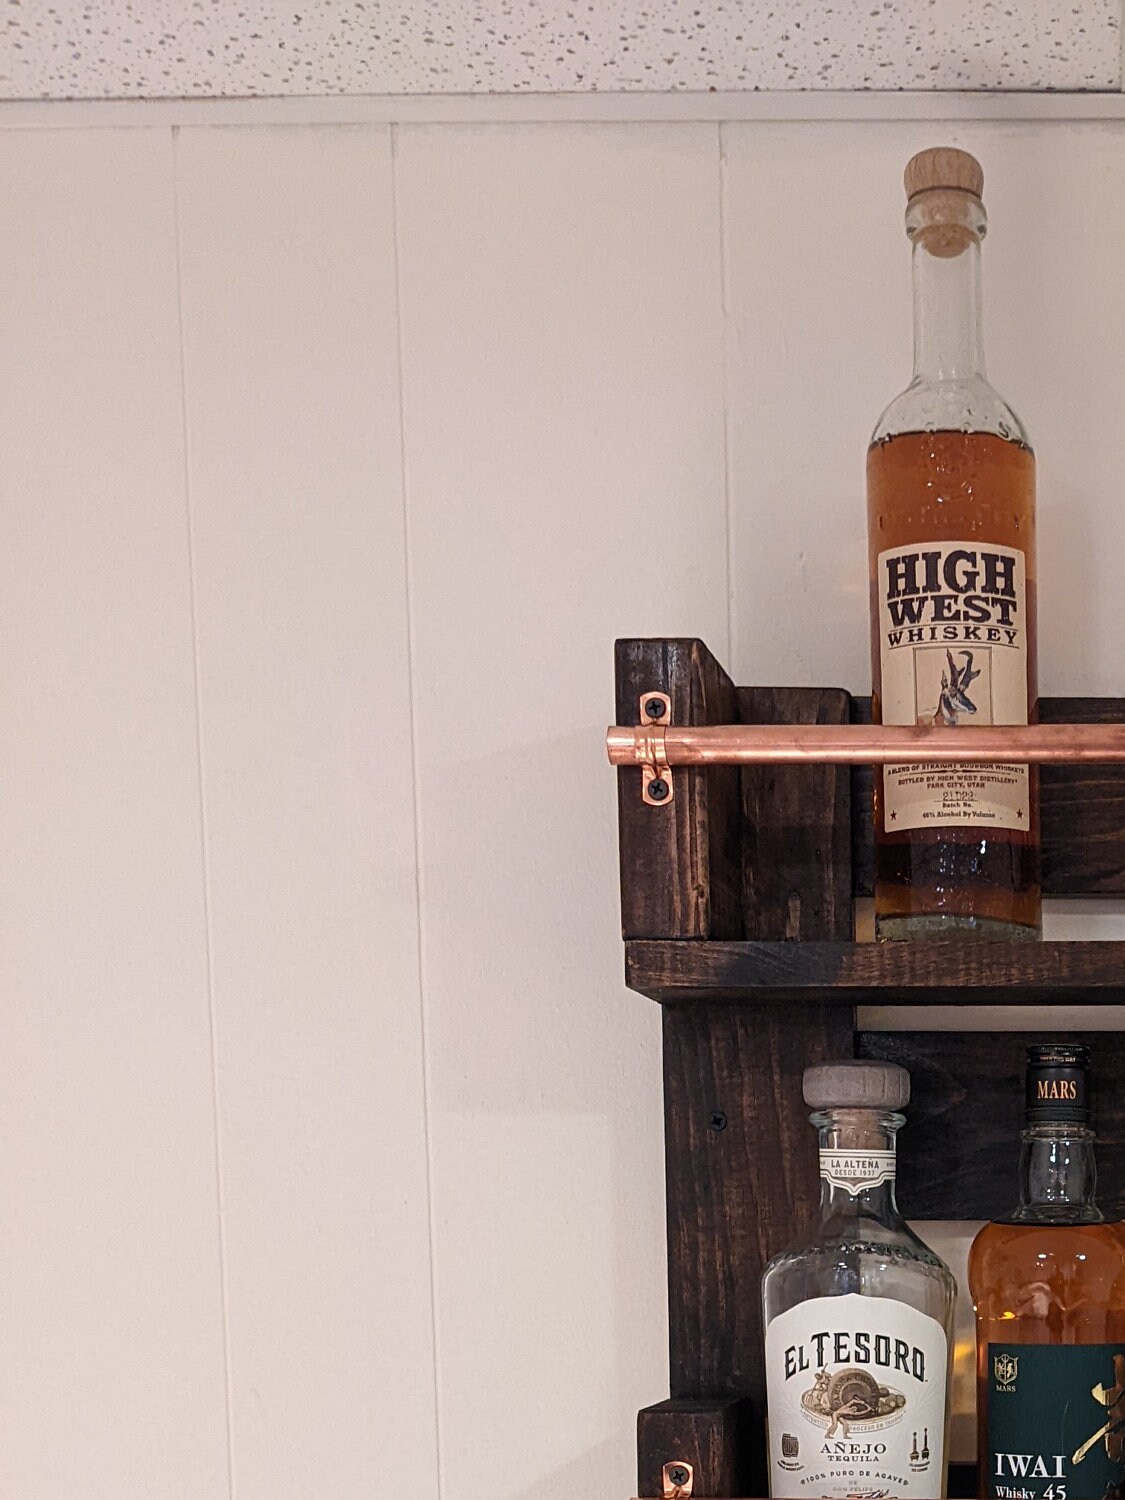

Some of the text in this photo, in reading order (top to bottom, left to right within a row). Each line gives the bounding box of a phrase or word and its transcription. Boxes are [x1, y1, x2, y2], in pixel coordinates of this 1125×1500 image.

[886, 550, 1016, 599] HIGH
[888, 595, 1017, 628] WEST
[888, 626, 1017, 646] WHISKEY
[898, 777, 924, 786] BOTTLED
[962, 811, 971, 819] By
[1037, 1080, 1077, 1100] MARS
[831, 1159, 841, 1168] LA
[844, 1158, 880, 1169] ALTEÑA
[784, 1332, 925, 1382] EL TESORO
[996, 1385, 1016, 1393] MARS
[820, 1441, 887, 1454] AÑEJO
[995, 1452, 1067, 1478] IWAI
[806, 1473, 826, 1483] 100%
[995, 1483, 1067, 1500] Whisky 45
